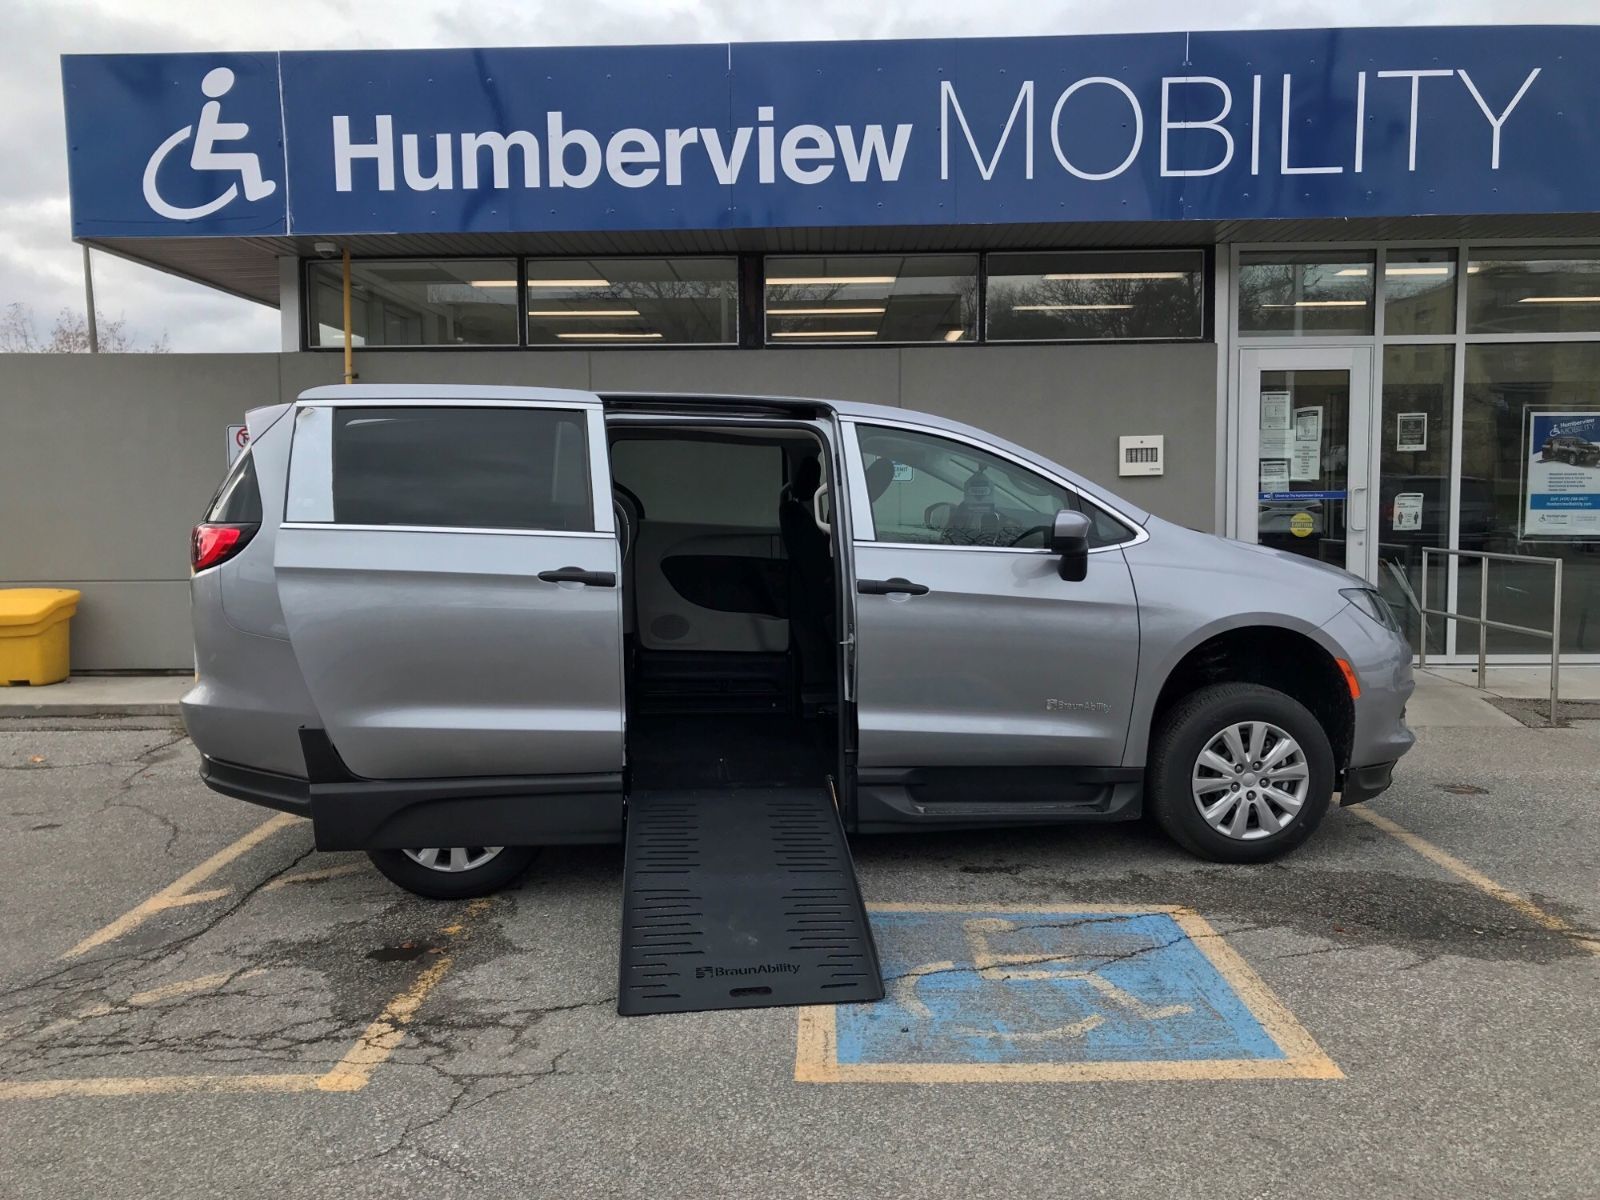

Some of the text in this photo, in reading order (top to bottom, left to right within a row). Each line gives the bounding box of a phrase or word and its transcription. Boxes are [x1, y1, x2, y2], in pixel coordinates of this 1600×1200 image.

[332, 68, 1542, 192] Humberview MOBILITY
[716, 963, 800, 976] BraunAbility
